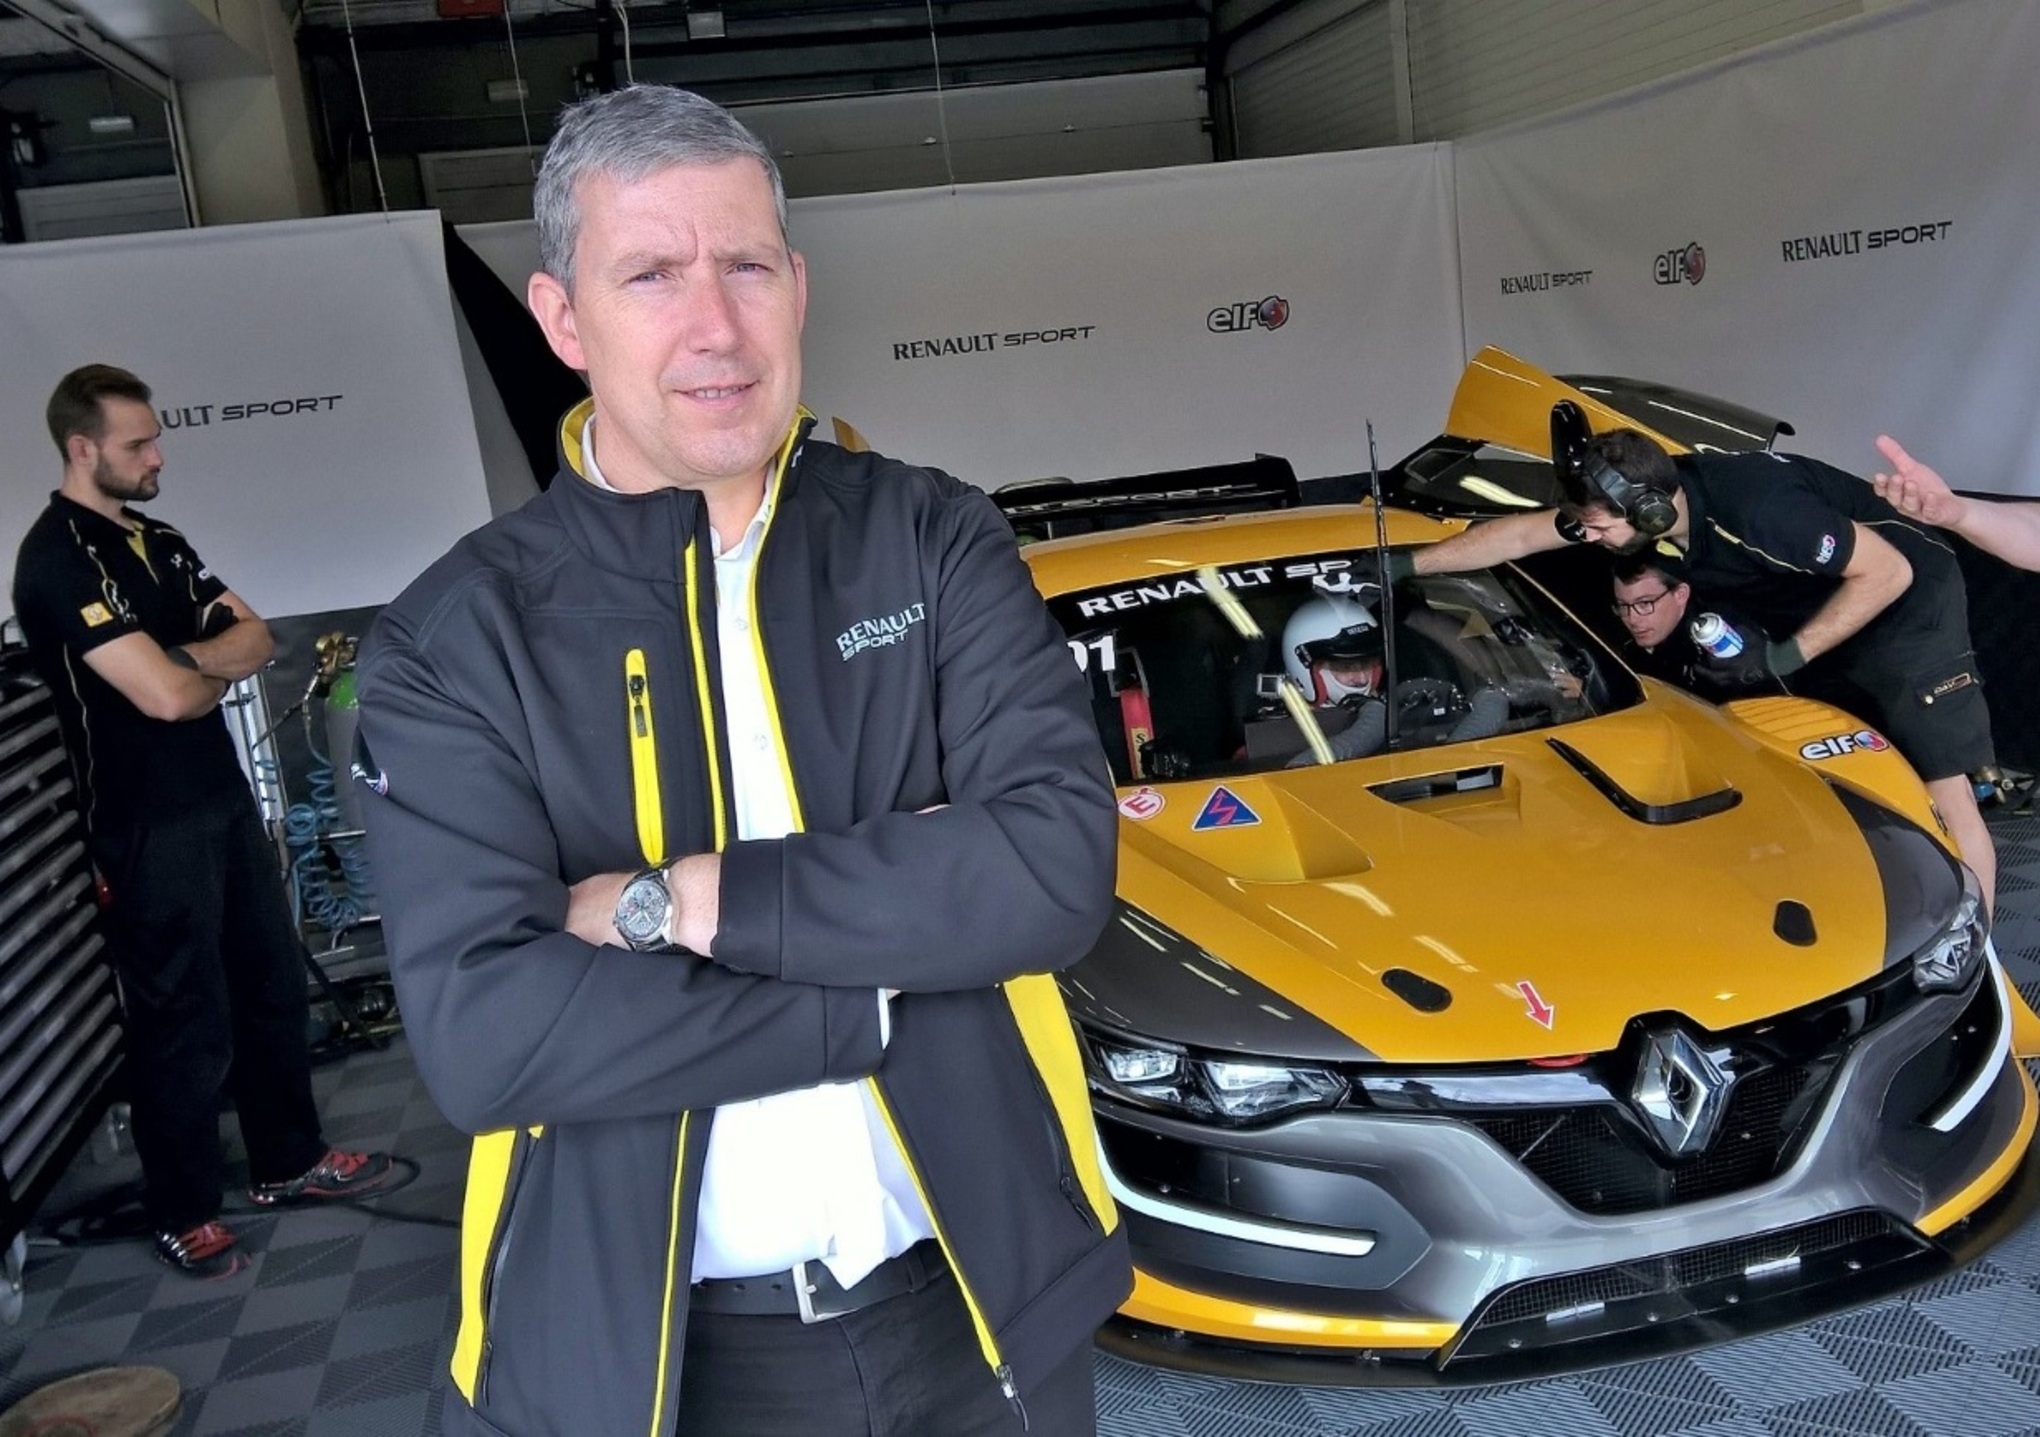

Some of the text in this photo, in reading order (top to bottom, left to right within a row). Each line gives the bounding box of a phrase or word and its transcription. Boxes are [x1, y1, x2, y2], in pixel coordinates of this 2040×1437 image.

[1781, 221, 1952, 262] RENAULT SPORT
[1501, 271, 1593, 295] RENAULT SPORT
[1653, 249, 1686, 285] elf
[1206, 301, 1259, 333] elf
[892, 326, 1096, 360] RENAULT SPORT
[222, 395, 343, 421] SPORT
[1077, 567, 1273, 618] RENAULT
[836, 602, 925, 652] RENAULT
[842, 628, 908, 661] SPORT
[1799, 733, 1855, 761] elf
